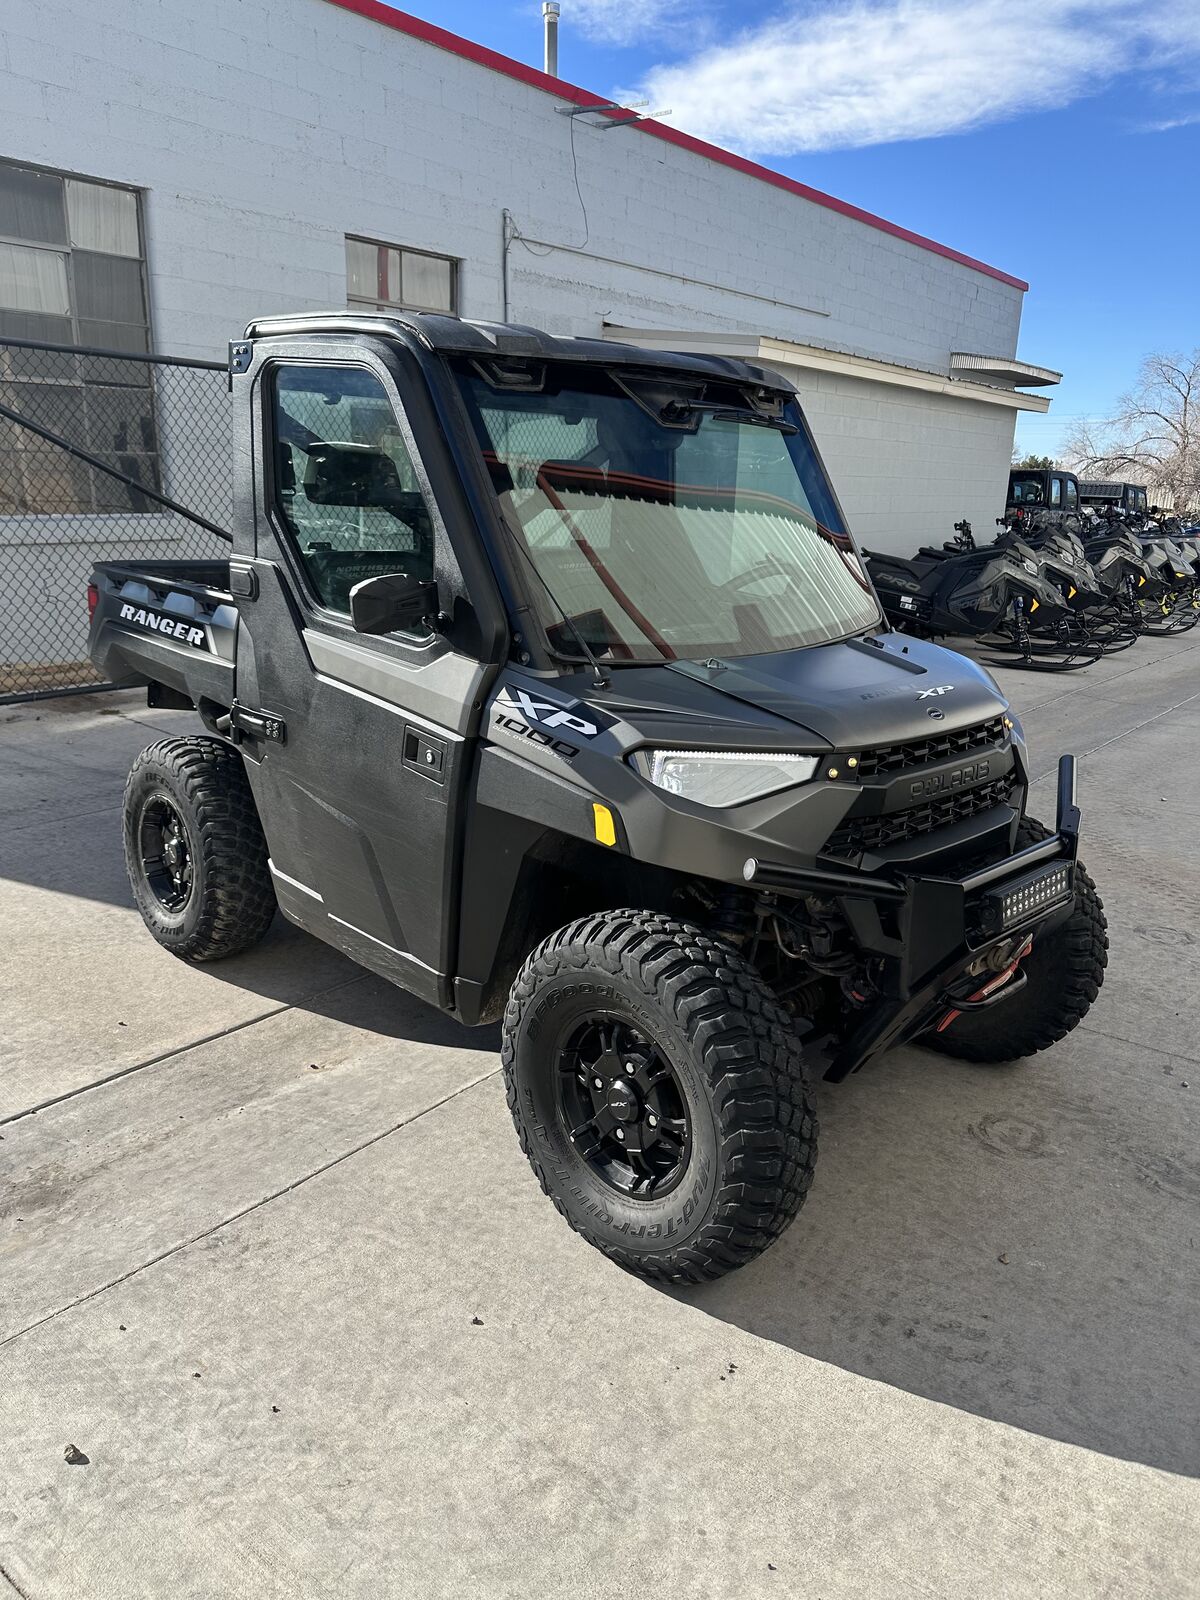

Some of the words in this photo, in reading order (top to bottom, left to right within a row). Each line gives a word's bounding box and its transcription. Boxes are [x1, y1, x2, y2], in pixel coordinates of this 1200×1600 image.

[335, 564, 405, 573] NORTHSTAR
[876, 572, 920, 590] PRO
[119, 603, 205, 646] RANGER
[495, 689, 598, 736] XP
[914, 685, 954, 701] XP
[494, 713, 581, 758] 1000
[909, 760, 990, 801] POLARIS
[526, 982, 676, 1051] BFGoodrich
